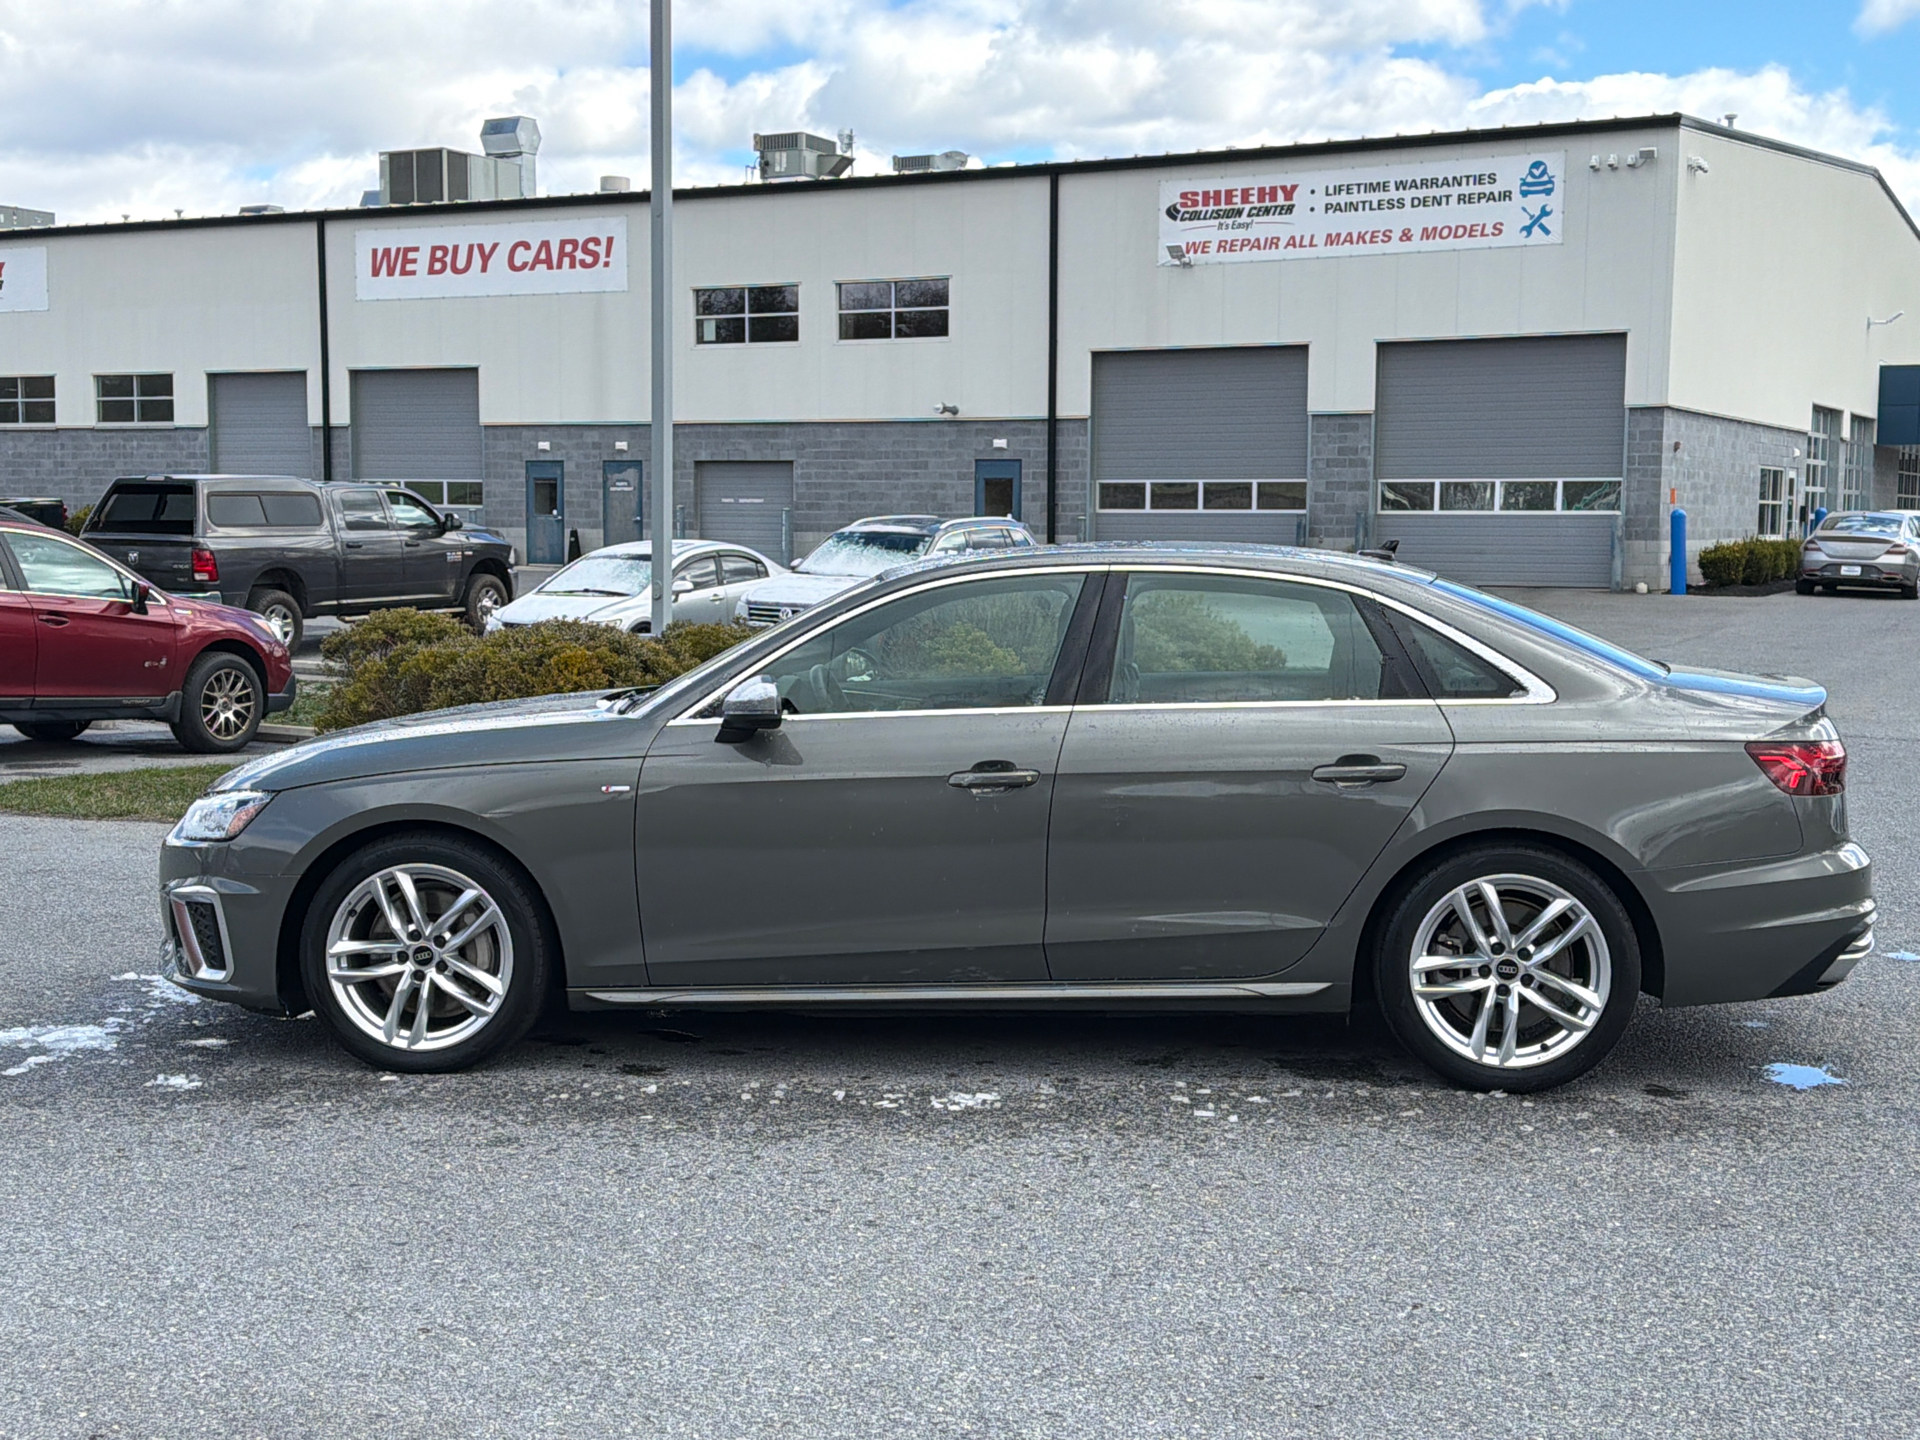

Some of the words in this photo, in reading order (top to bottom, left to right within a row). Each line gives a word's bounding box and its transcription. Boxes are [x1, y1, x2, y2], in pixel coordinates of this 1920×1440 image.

[1179, 184, 1300, 209] SHEEHY
[1325, 181, 1391, 197] LIFETIME
[1394, 172, 1497, 192] WARRANTIES
[1179, 207, 1245, 222] COLLISION
[1246, 204, 1296, 218] CENTER
[1324, 197, 1406, 214] PAINTLESS
[1410, 194, 1453, 209] DENT
[1457, 190, 1513, 206] REPAIR
[1217, 221, 1230, 231] It's
[1231, 219, 1254, 232] Easy!
[1185, 241, 1212, 255] WE
[1216, 236, 1281, 254] REPAIR
[1283, 234, 1318, 250] ALL
[1324, 229, 1393, 247] MAKES
[1398, 228, 1414, 243] &
[1419, 222, 1505, 241] MODELS
[371, 246, 420, 277] WE
[427, 242, 500, 275] BUY
[507, 236, 614, 272] CARS!
